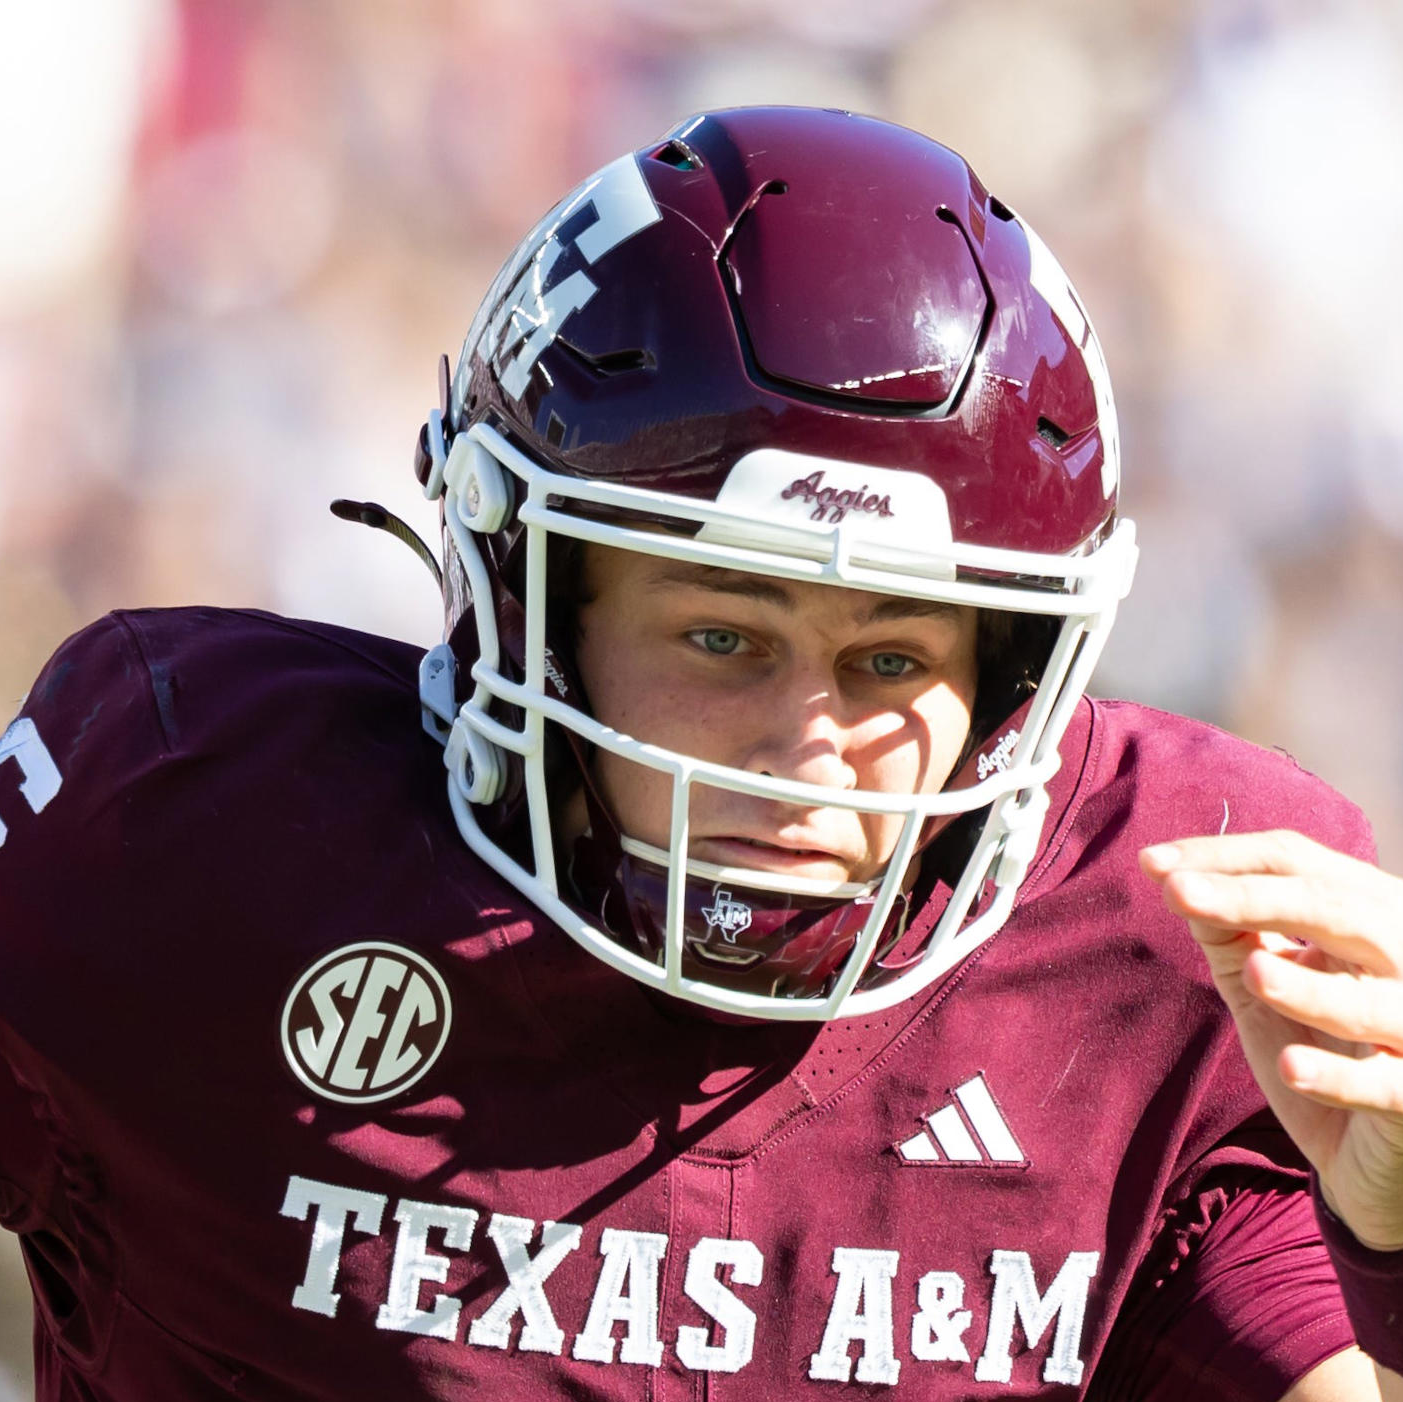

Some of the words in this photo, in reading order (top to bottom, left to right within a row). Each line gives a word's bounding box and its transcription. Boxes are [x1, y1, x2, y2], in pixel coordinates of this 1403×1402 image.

[781, 470, 895, 524] Aggies
[295, 956, 438, 1090] SEC
[280, 1175, 764, 1374] TEXAS
[809, 1247, 1100, 1386] A&M
